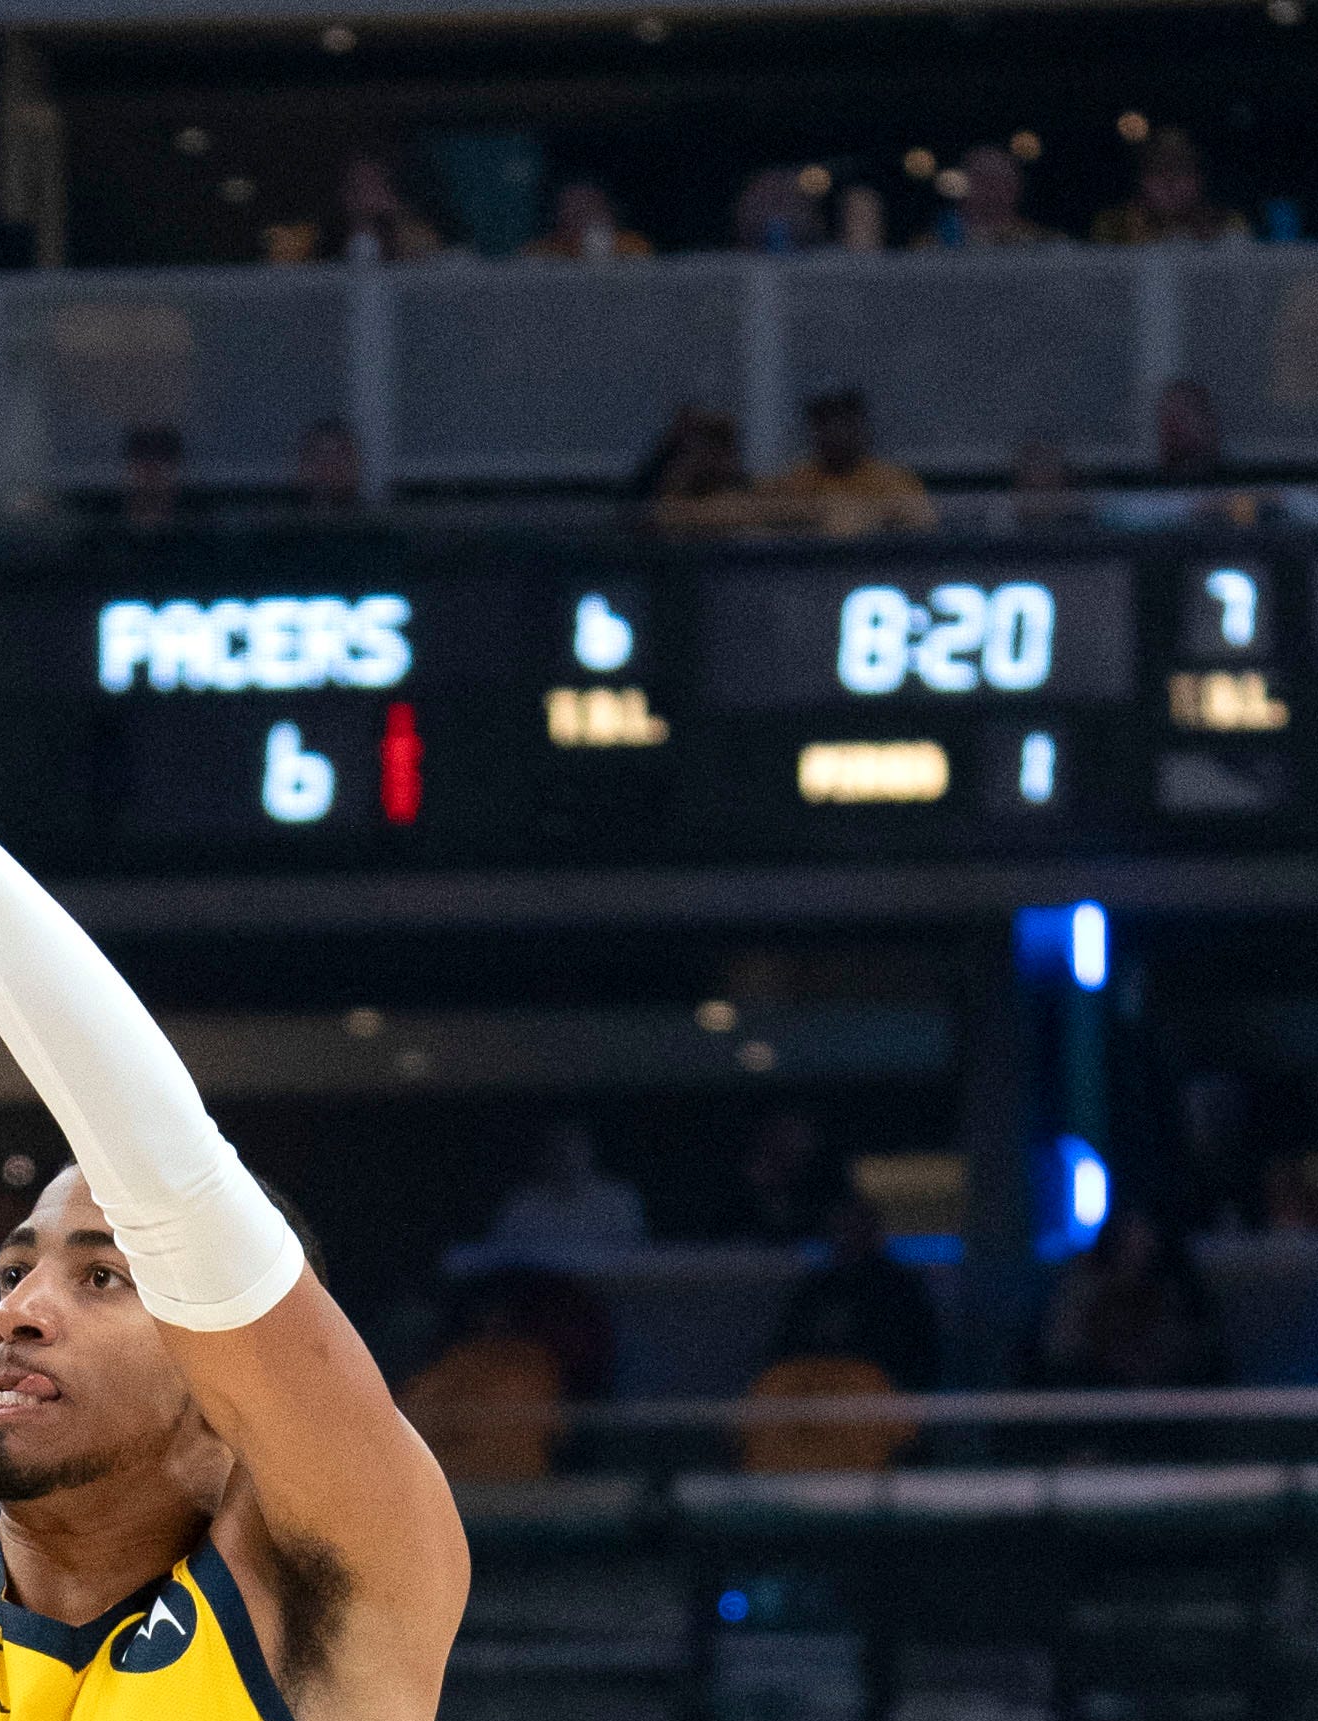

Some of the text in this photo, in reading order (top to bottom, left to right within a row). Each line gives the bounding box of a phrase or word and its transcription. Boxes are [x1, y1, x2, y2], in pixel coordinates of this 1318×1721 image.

[97, 593, 414, 693] PACERS
[837, 581, 1057, 696] 8:20
[262, 719, 337, 824] 6
